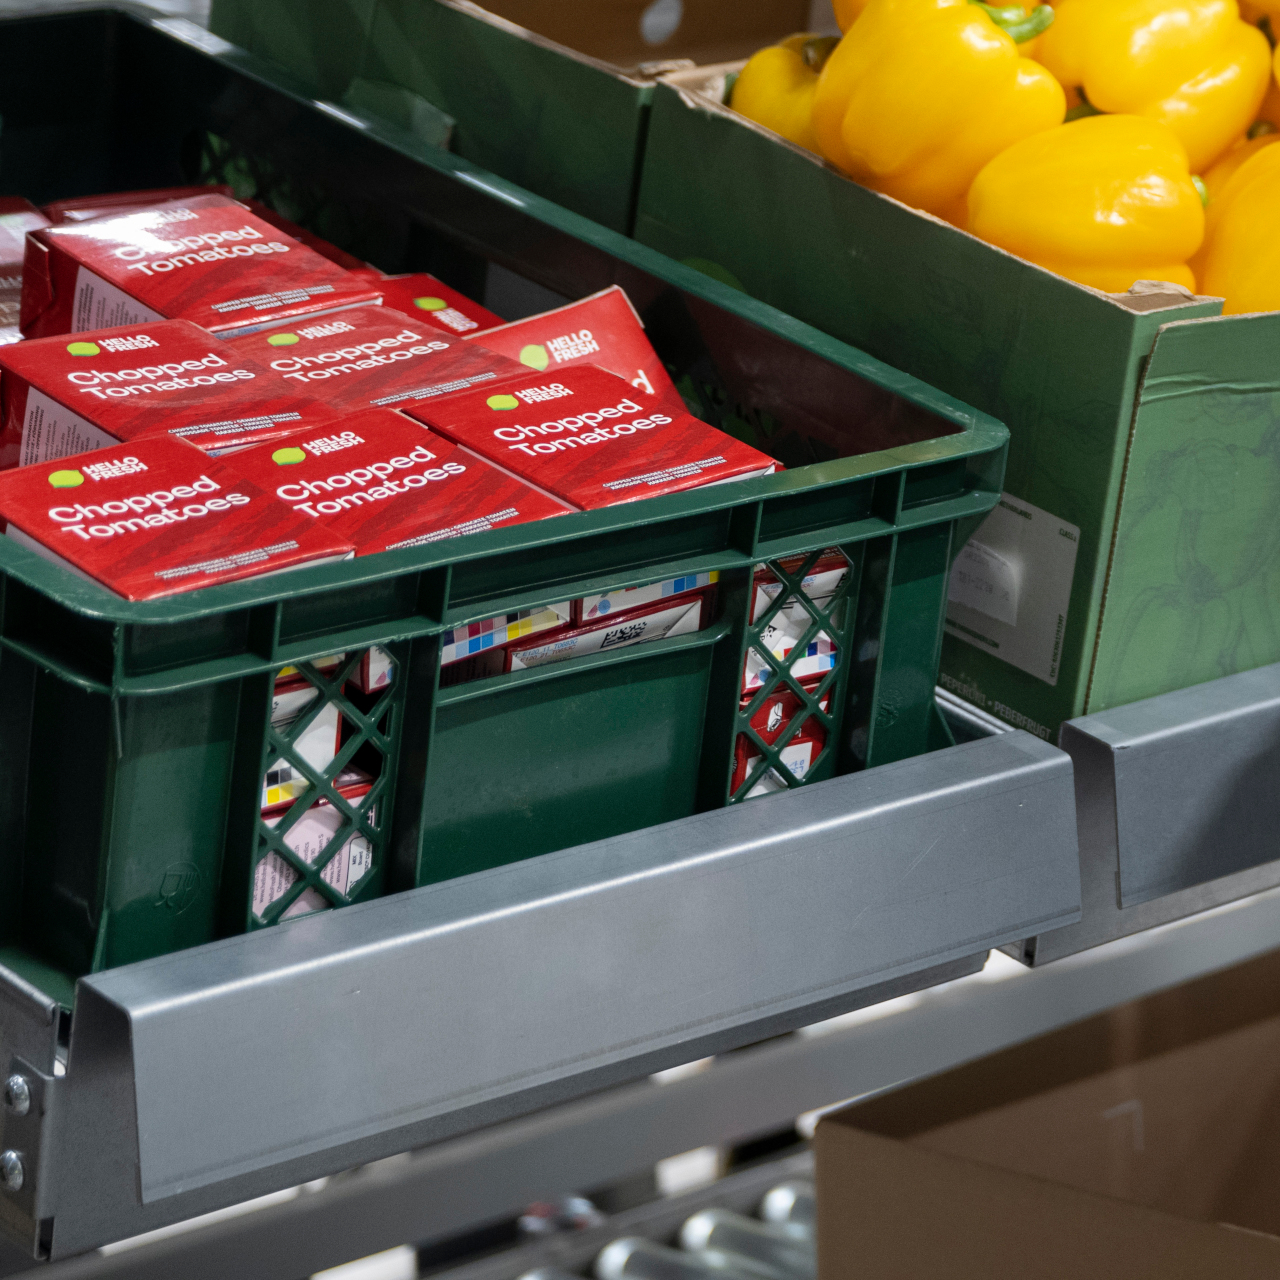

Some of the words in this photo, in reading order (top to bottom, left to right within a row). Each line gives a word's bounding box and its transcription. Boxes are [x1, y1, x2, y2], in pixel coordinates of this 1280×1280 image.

[114, 225, 263, 260] Cpped
[127, 241, 290, 276] Tomatoes
[98, 335, 150, 347] HELLO
[106, 340, 160, 352] FRESH
[270, 330, 422, 371] Chopped
[546, 329, 593, 350] HELLO
[552, 340, 600, 363] FRESH
[68, 354, 228, 384] Chopped
[283, 340, 450, 382] Tomatoes
[80, 370, 256, 399] Tomatoes
[514, 383, 564, 398] HELLO
[522, 388, 574, 404] FRESH
[26, 411, 34, 451] INFORMATION
[494, 398, 643, 442] Chopped
[509, 412, 672, 456] Tomatoes
[302, 431, 356, 450] HELLO
[310, 436, 365, 456] FRESH
[82, 456, 139, 474] HELLO
[90, 462, 148, 481] FRESH
[276, 446, 436, 500] Chopped
[48, 475, 221, 523] Chopped
[293, 462, 466, 518] Tomatoes
[61, 493, 250, 540] Tomatoes
[994, 700, 1052, 741] PEBERFRUGT
